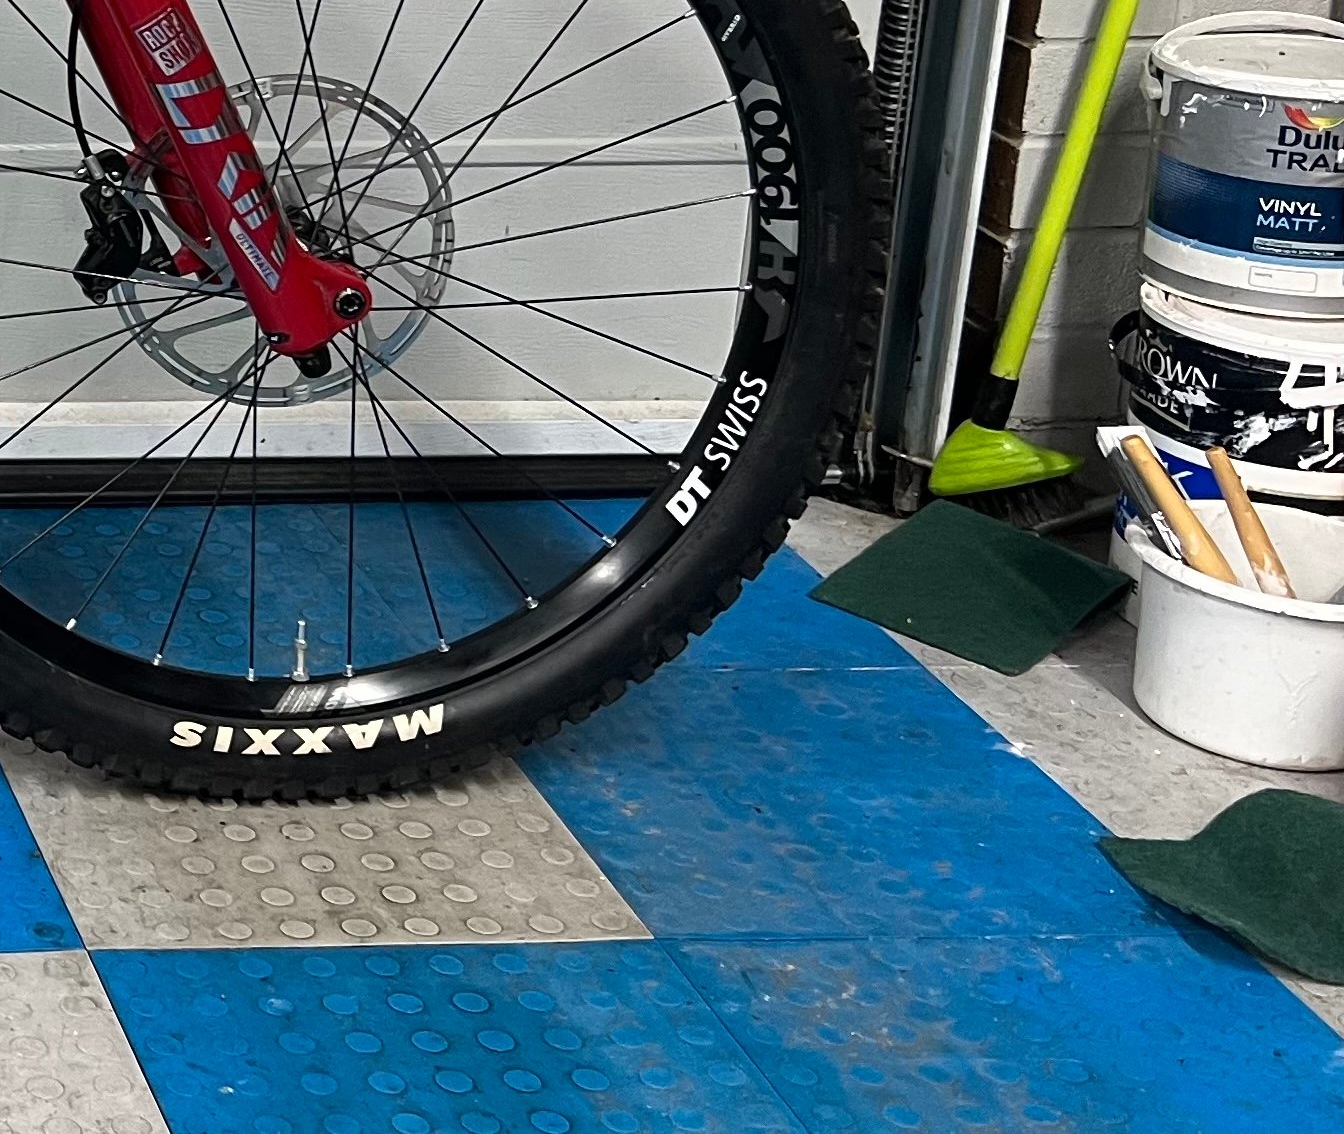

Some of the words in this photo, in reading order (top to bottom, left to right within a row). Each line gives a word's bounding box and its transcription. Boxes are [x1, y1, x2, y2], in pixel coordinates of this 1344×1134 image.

[1278, 125, 1344, 152] Dulu
[1256, 214, 1319, 232] MATT
[1259, 197, 1321, 216] VINYL
[1138, 337, 1218, 388] ROWN
[665, 466, 714, 526] DT
[704, 370, 768, 471] SWISS
[169, 703, 445, 755] MAXXIS
